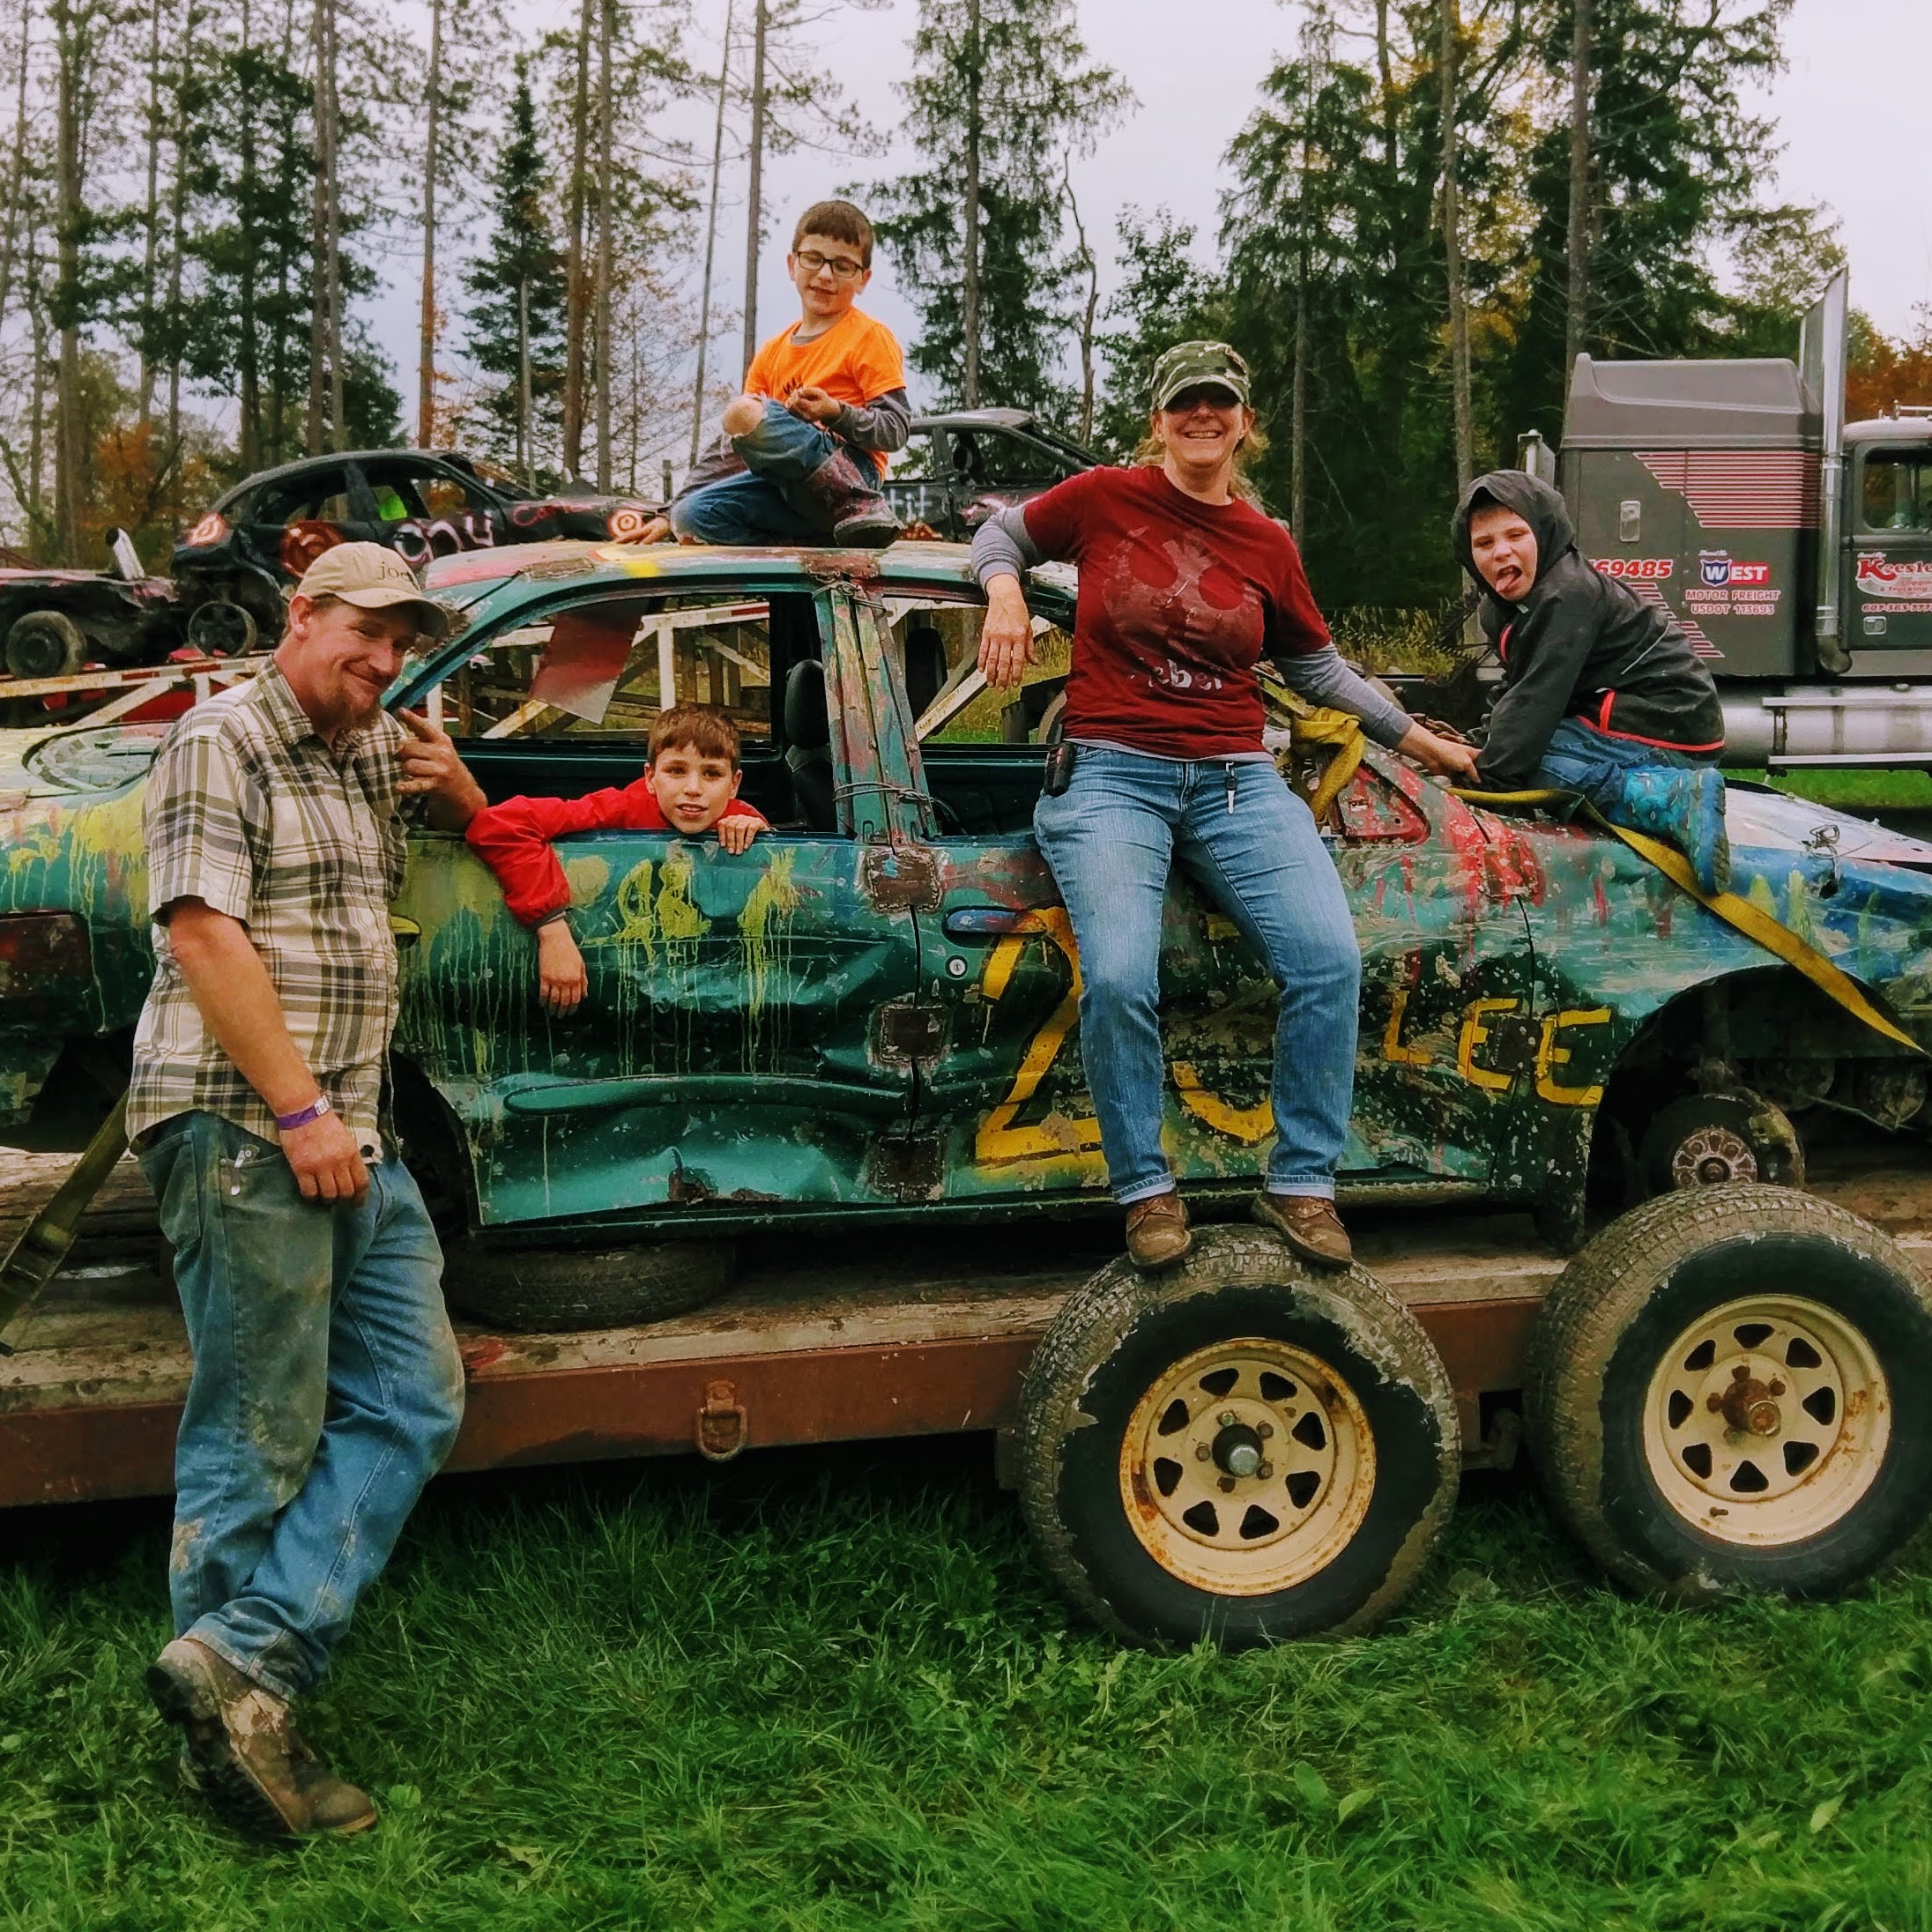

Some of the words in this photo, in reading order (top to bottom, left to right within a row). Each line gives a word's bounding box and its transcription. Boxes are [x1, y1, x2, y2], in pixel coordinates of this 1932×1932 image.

[1588, 558, 1673, 579] 69485
[1705, 565, 1768, 581] WEST
[1685, 589, 1728, 600] MOTOR
[1731, 590, 1781, 601] FREIGHT
[1690, 604, 1731, 615] USDOT
[1733, 604, 1775, 615] 113693
